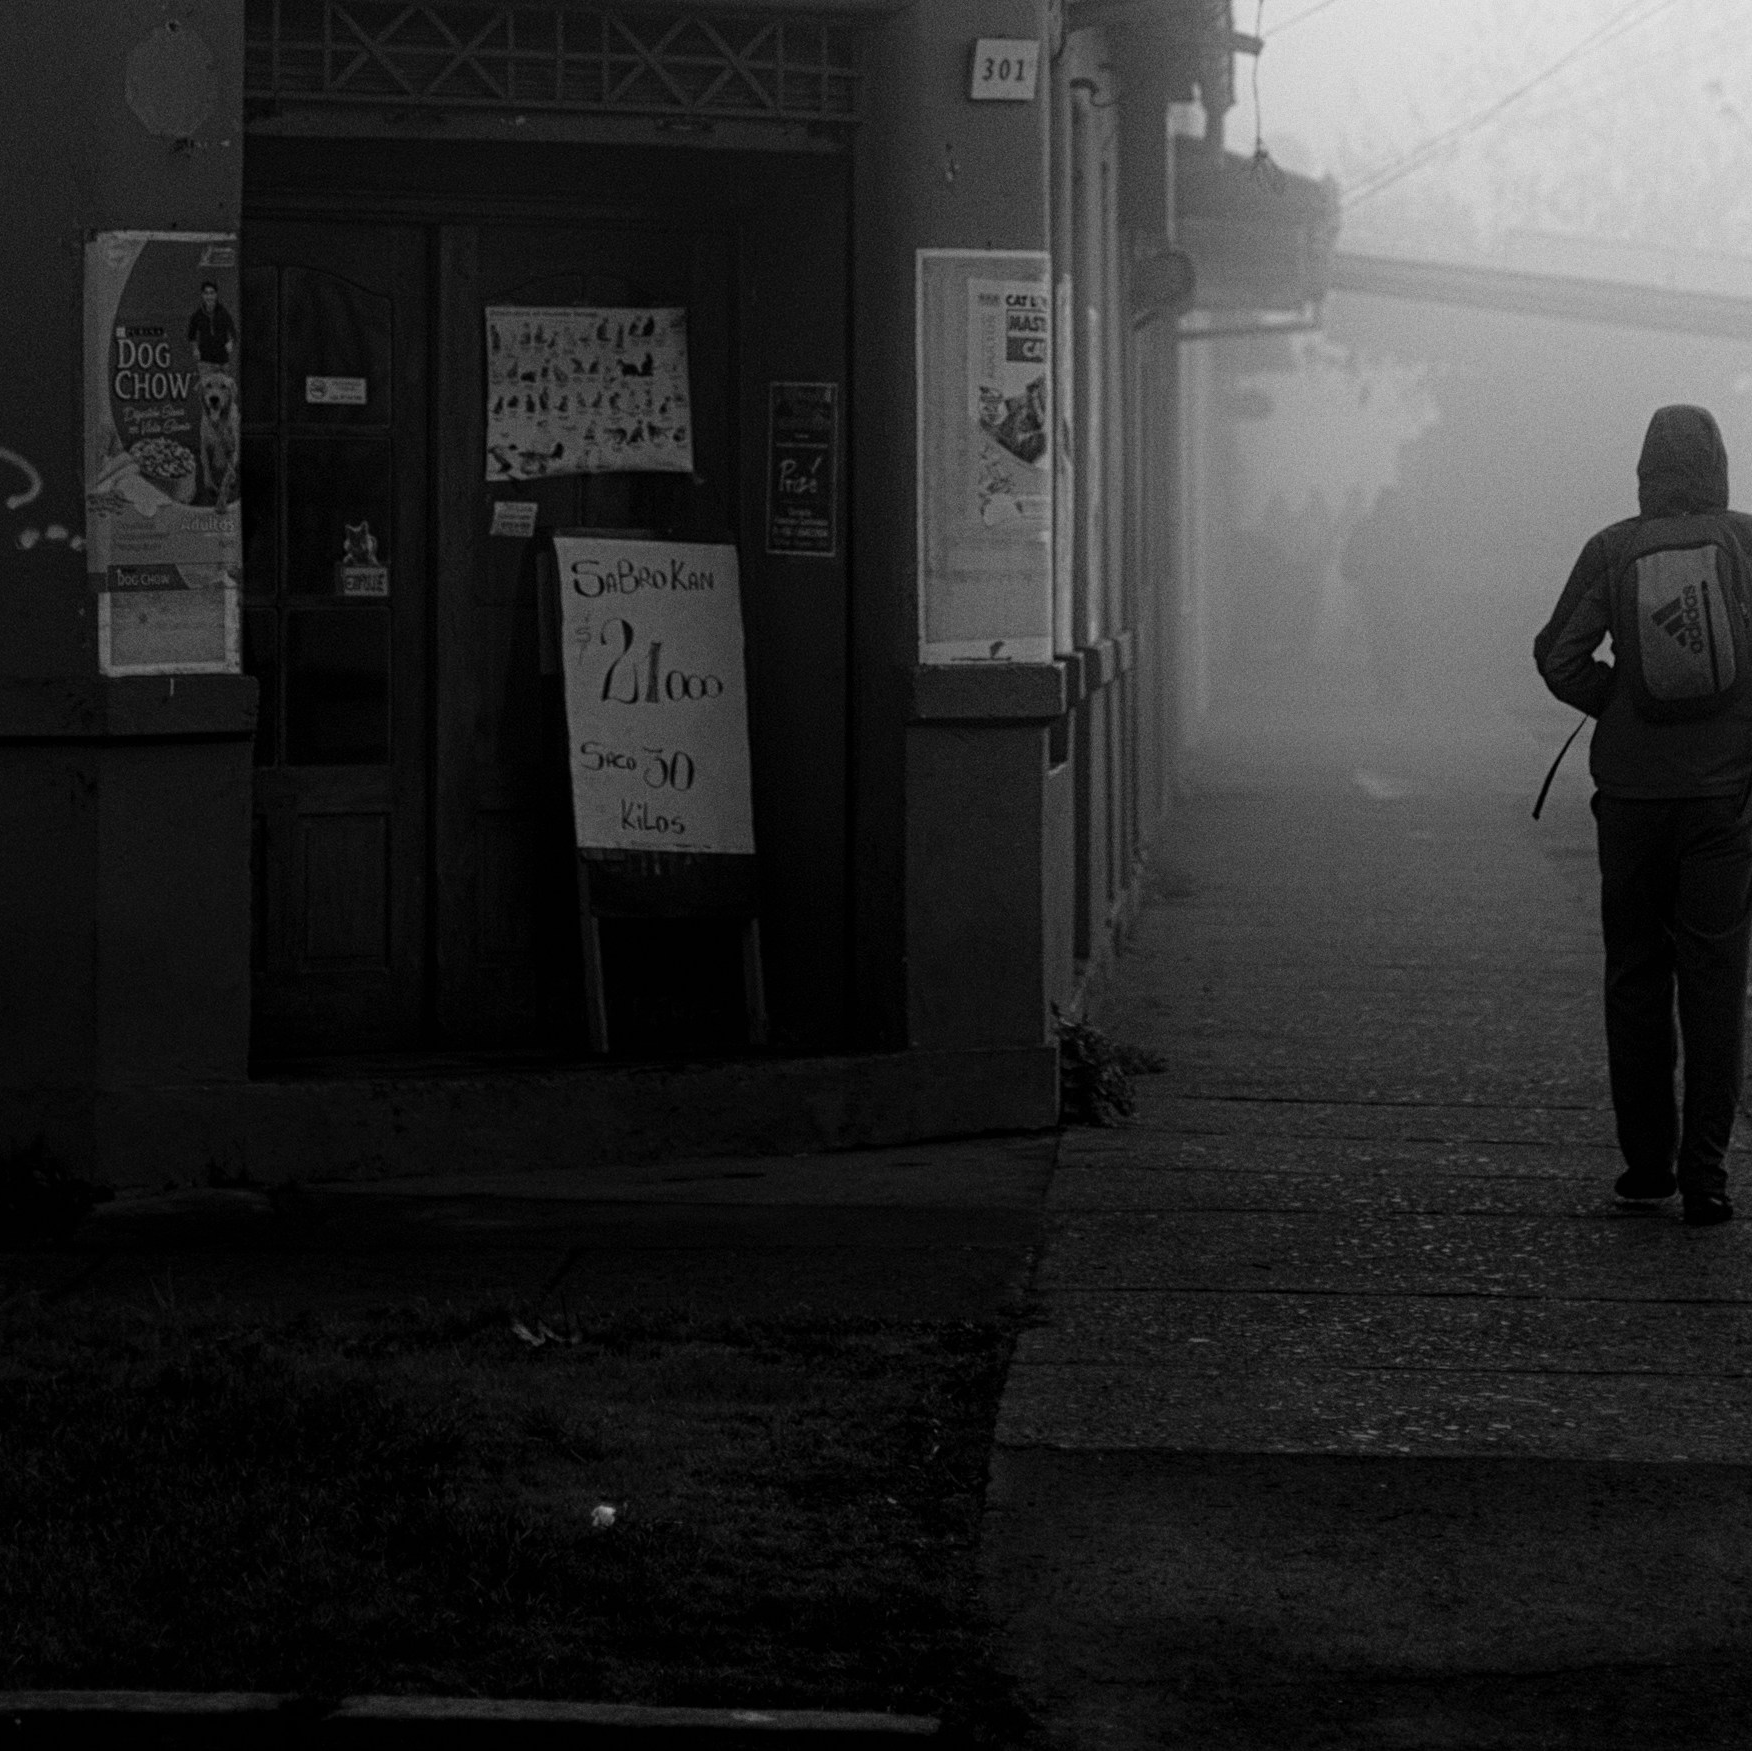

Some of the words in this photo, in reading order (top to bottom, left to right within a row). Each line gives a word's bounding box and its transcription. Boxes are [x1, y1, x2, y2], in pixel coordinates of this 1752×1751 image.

[981, 57, 1025, 82] 301
[116, 338, 172, 369] DOG
[113, 369, 192, 400] CHOW
[180, 515, 236, 532] Adultos
[1682, 585, 1704, 655] adidas
